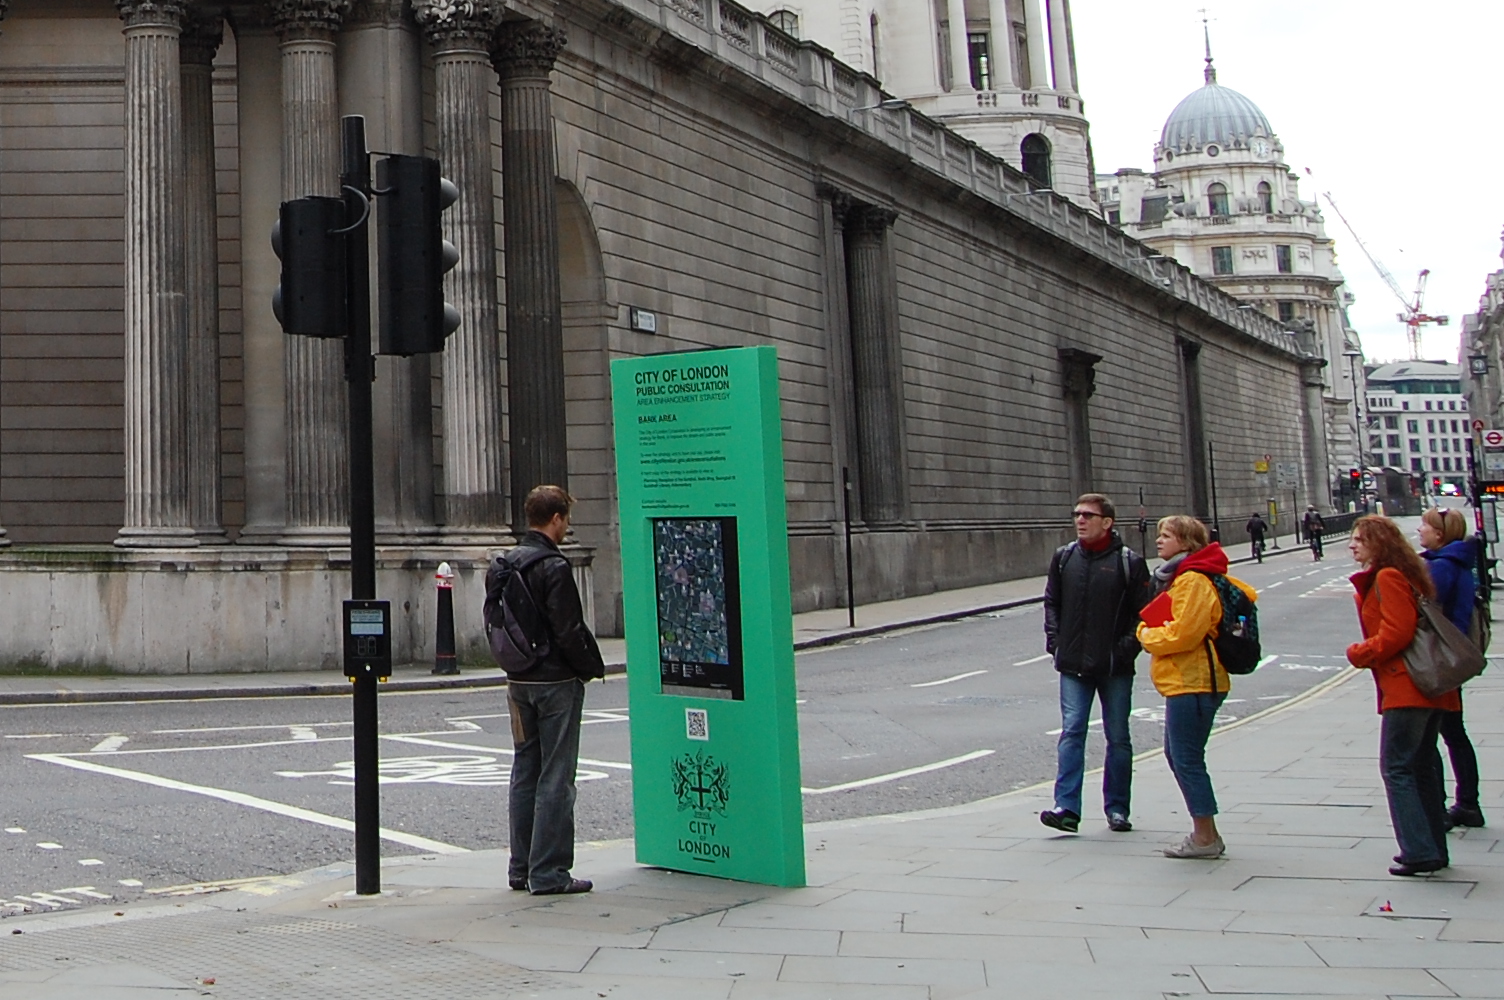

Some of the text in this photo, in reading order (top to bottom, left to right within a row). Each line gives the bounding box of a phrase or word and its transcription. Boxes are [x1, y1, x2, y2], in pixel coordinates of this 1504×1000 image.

[635, 364, 728, 384] CITY OF LONDON
[636, 380, 730, 396] PUBLIC CONSULTATION
[637, 398, 653, 406] AREA
[638, 414, 677, 424] BANK AREA
[689, 821, 716, 836] CITY
[678, 838, 730, 859] LONDON
